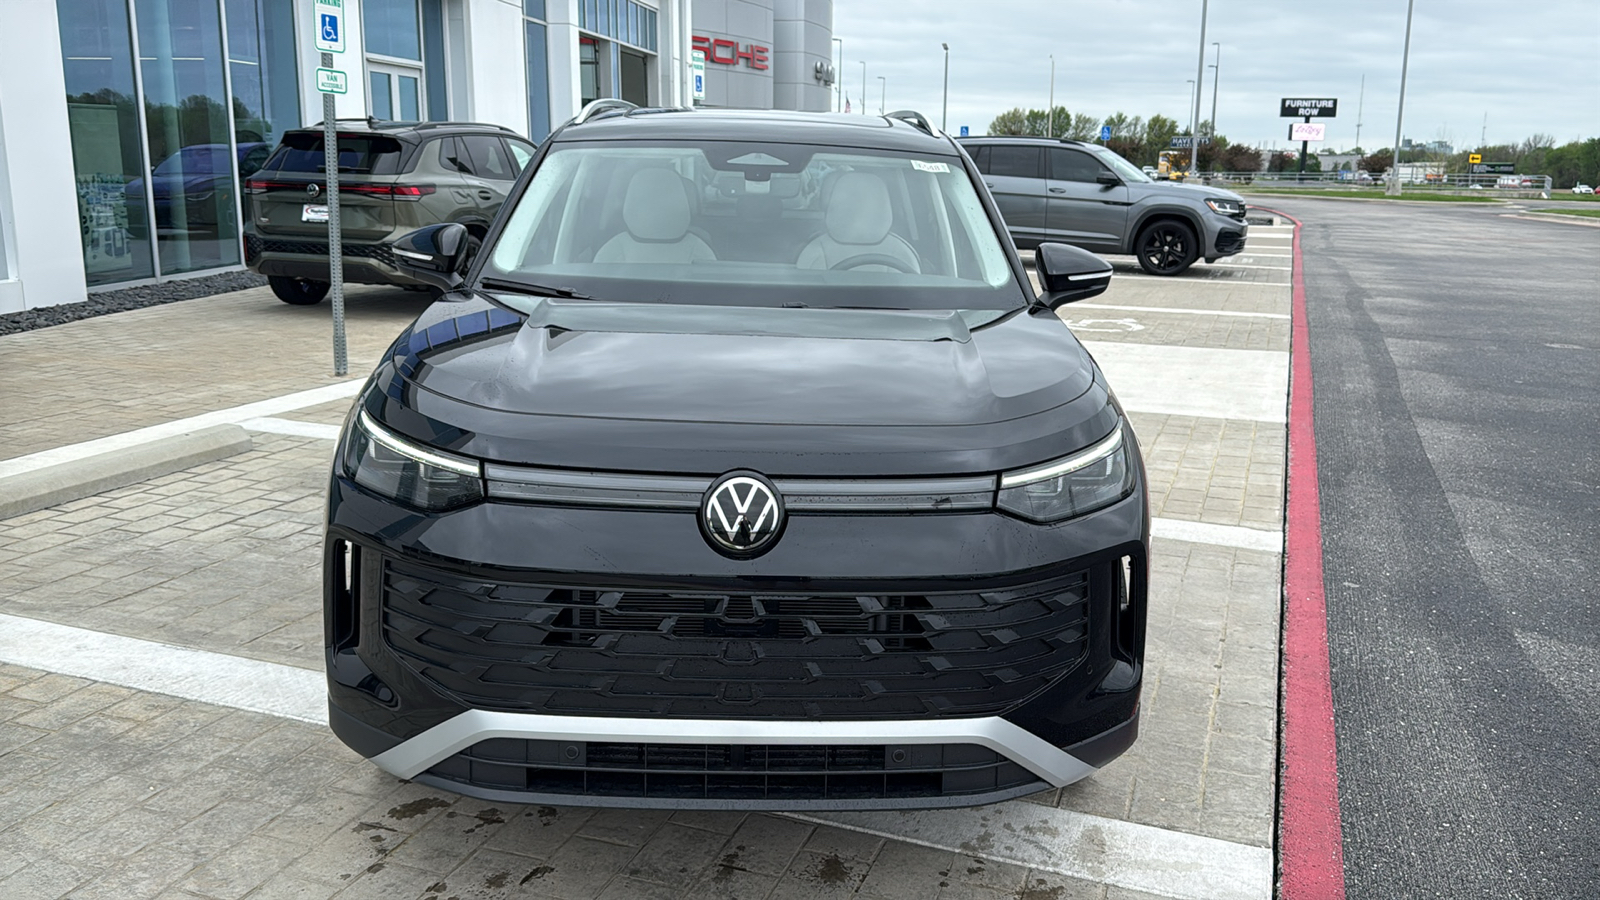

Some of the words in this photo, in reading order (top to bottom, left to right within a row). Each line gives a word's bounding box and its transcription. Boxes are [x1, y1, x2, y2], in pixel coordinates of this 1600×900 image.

[326, 74, 338, 82] VAN
[1285, 100, 1334, 108] FURNITURE
[1298, 108, 1319, 116] ROW
[1172, 137, 1210, 145] HAVETYS
